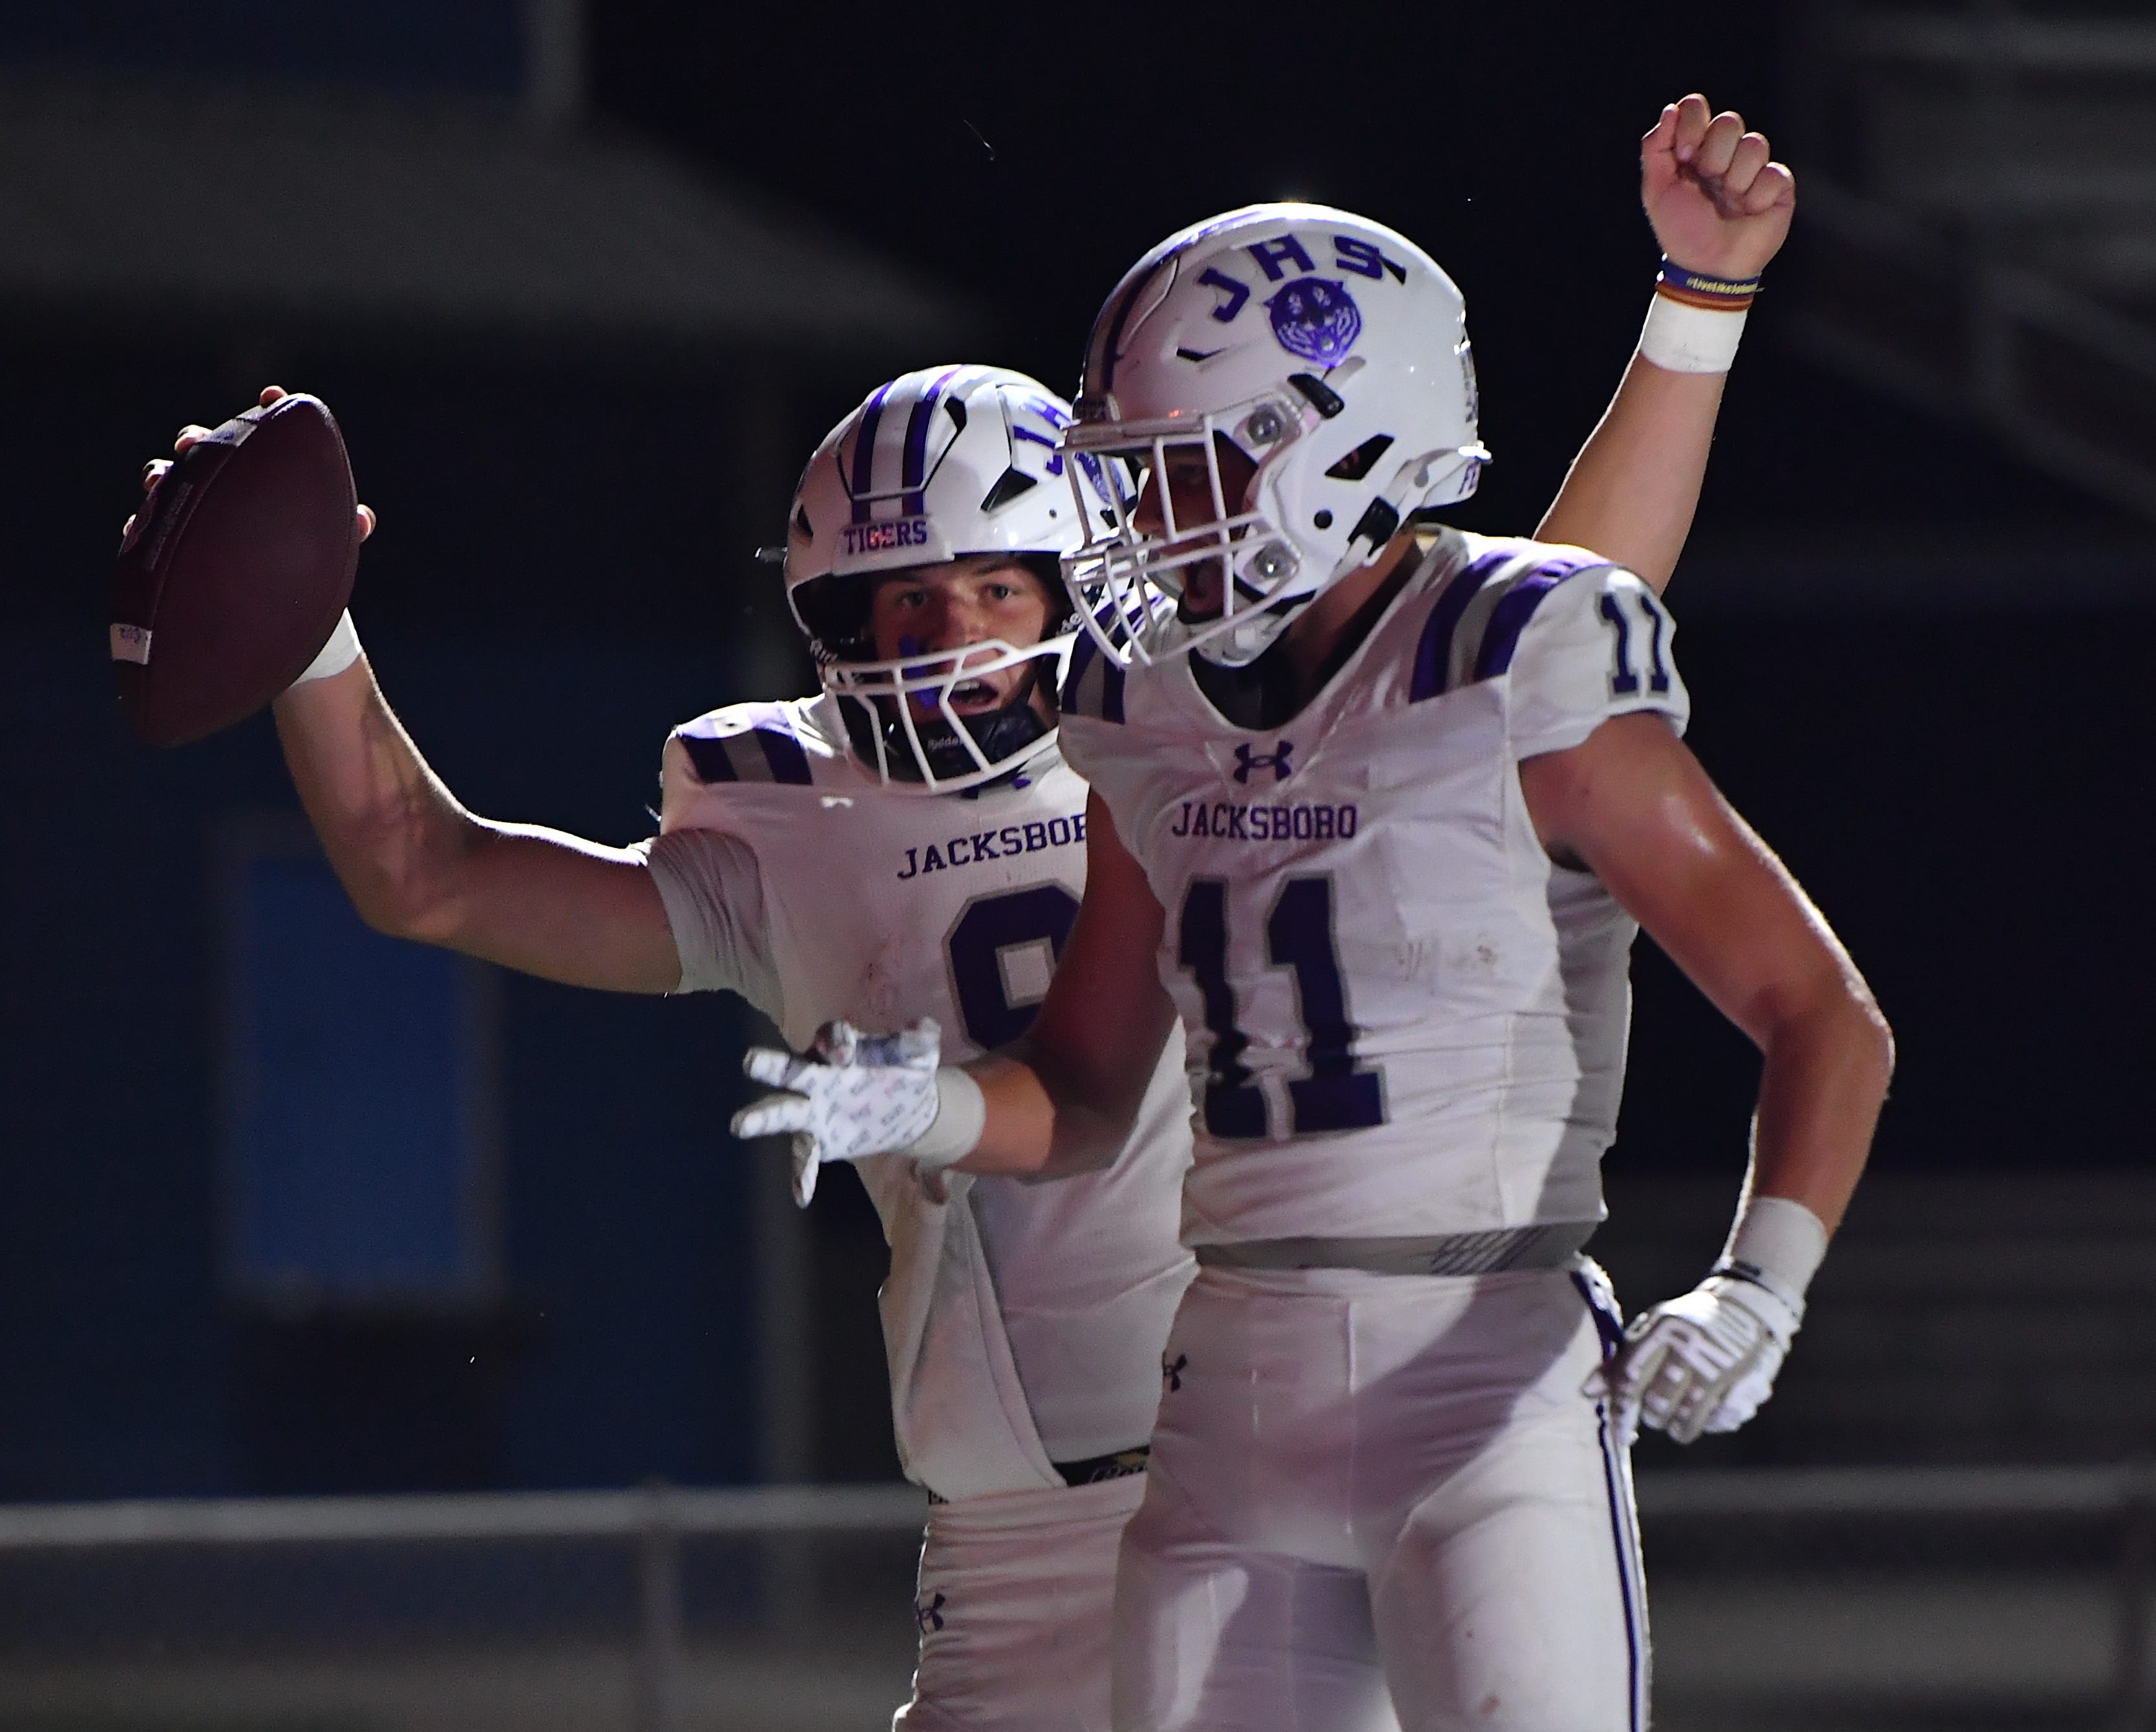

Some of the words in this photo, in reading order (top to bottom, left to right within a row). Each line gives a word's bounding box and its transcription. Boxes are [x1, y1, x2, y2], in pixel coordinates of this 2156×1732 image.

[1198, 233, 1383, 323] JHS
[843, 519, 928, 556] TIGERS
[1594, 589, 1669, 701] 11
[896, 812, 1086, 880] JACKSBOR
[1172, 803, 1357, 840] JACKSBORO
[1176, 870, 1391, 1139] 11
